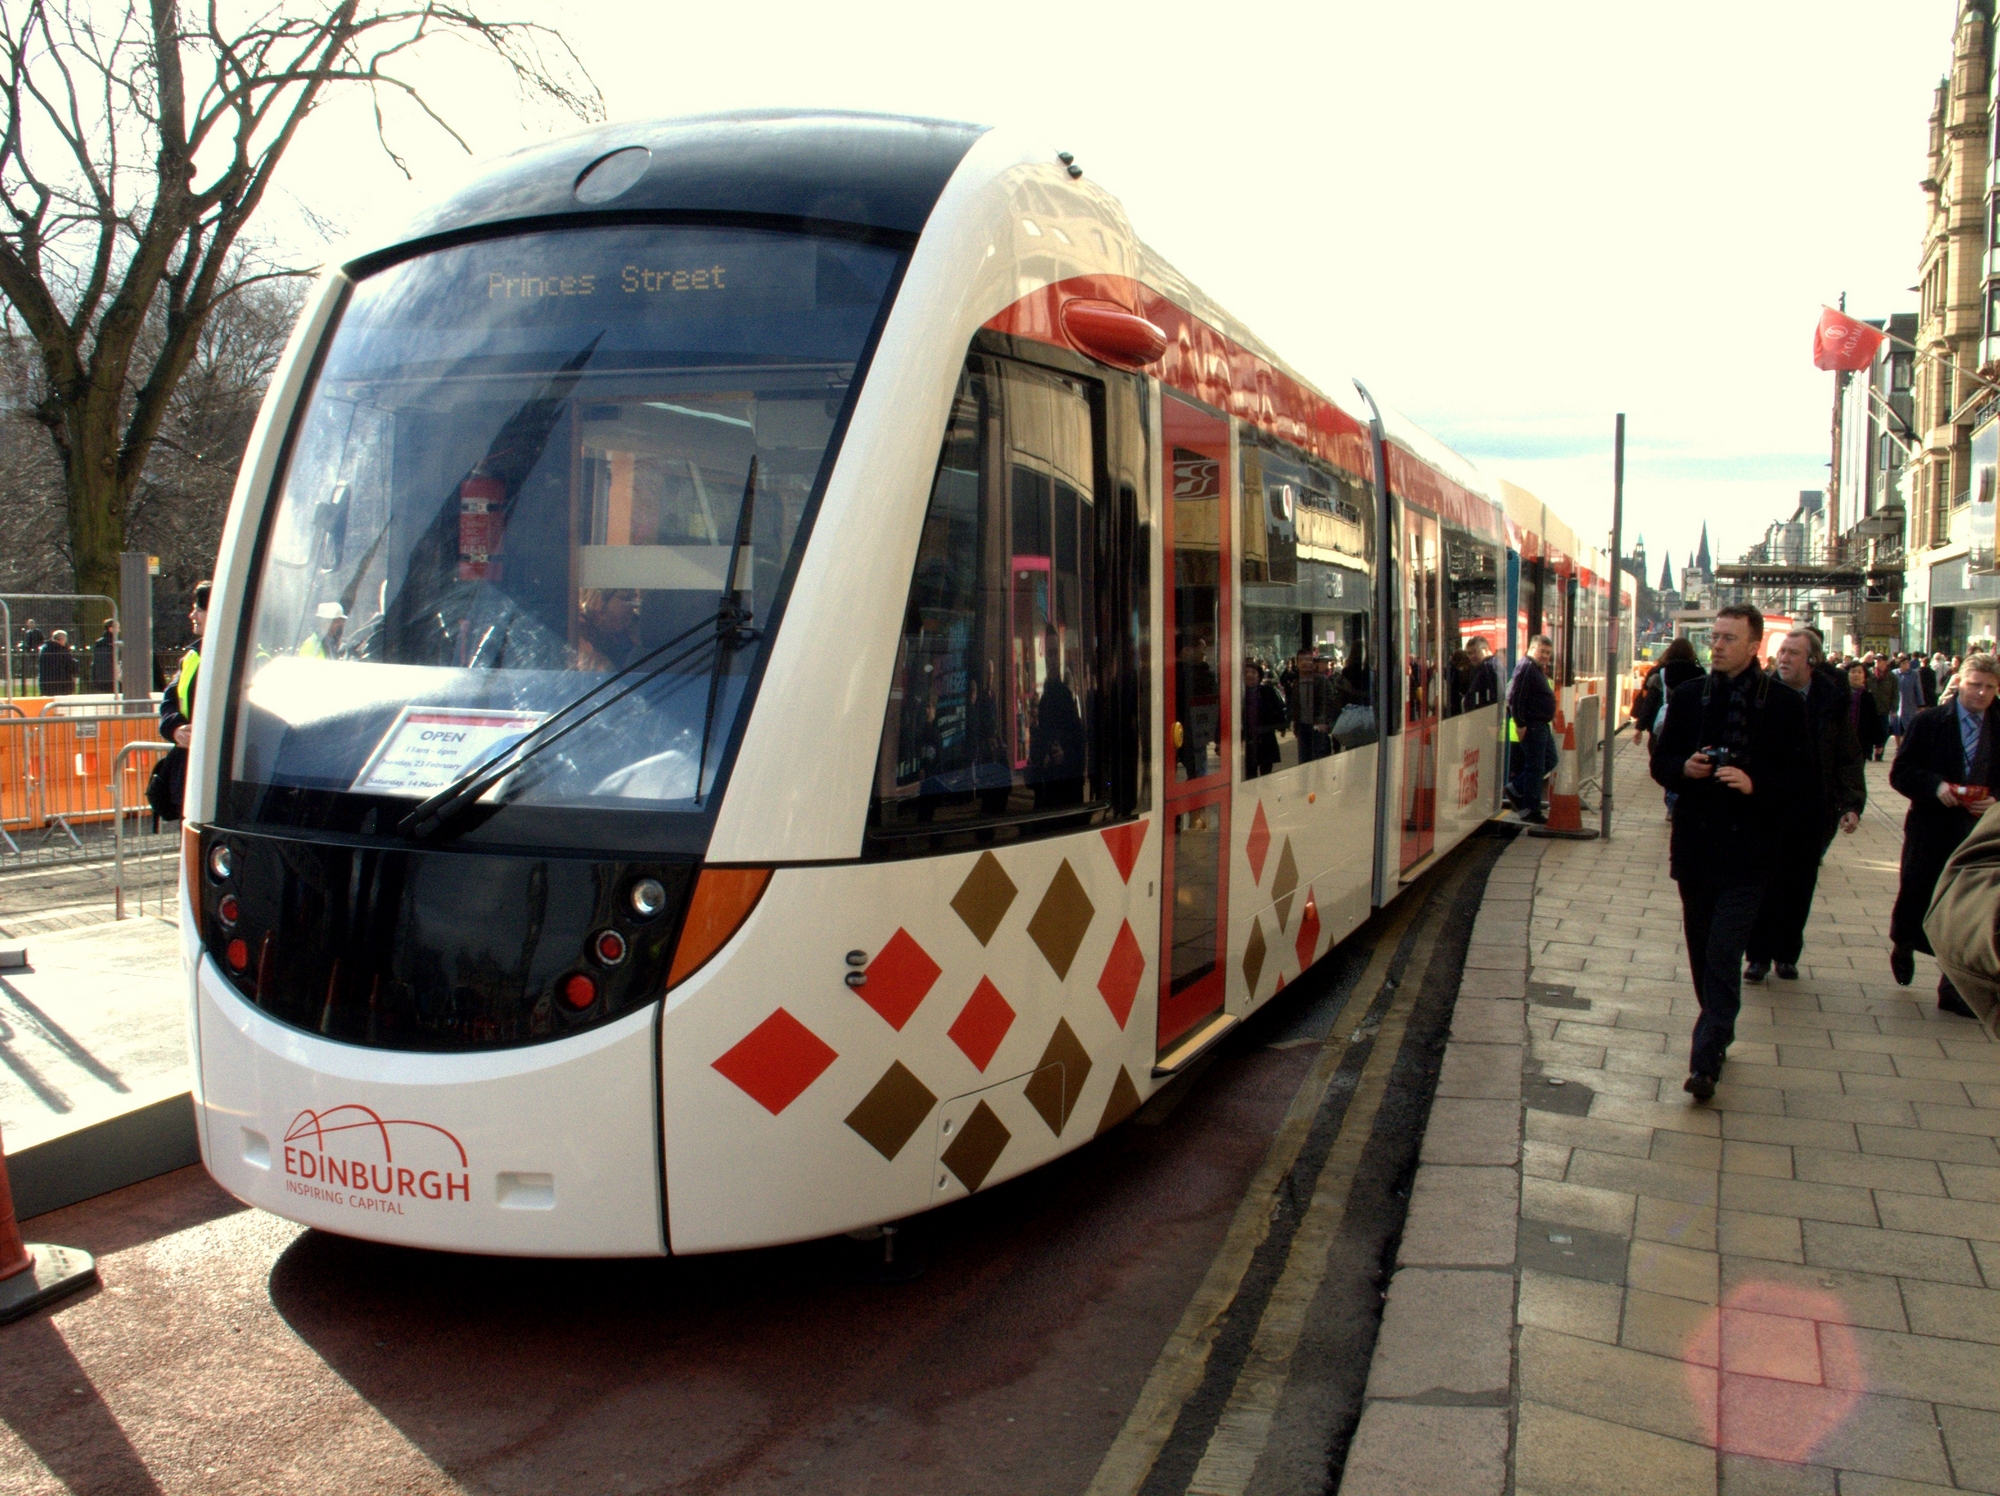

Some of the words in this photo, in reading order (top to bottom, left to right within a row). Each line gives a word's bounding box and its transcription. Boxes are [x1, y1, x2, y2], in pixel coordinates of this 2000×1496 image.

[488, 271, 596, 298] Princes
[620, 265, 726, 293] Street
[420, 730, 466, 743] OPEN
[405, 746, 429, 755] 11am
[437, 748, 458, 757] 6pm
[414, 760, 425, 768] 23
[426, 761, 462, 771] February
[284, 1145, 470, 1202] EDINBURGH
[286, 1179, 343, 1205] INSPIRING
[349, 1195, 405, 1216] CAPITAL
